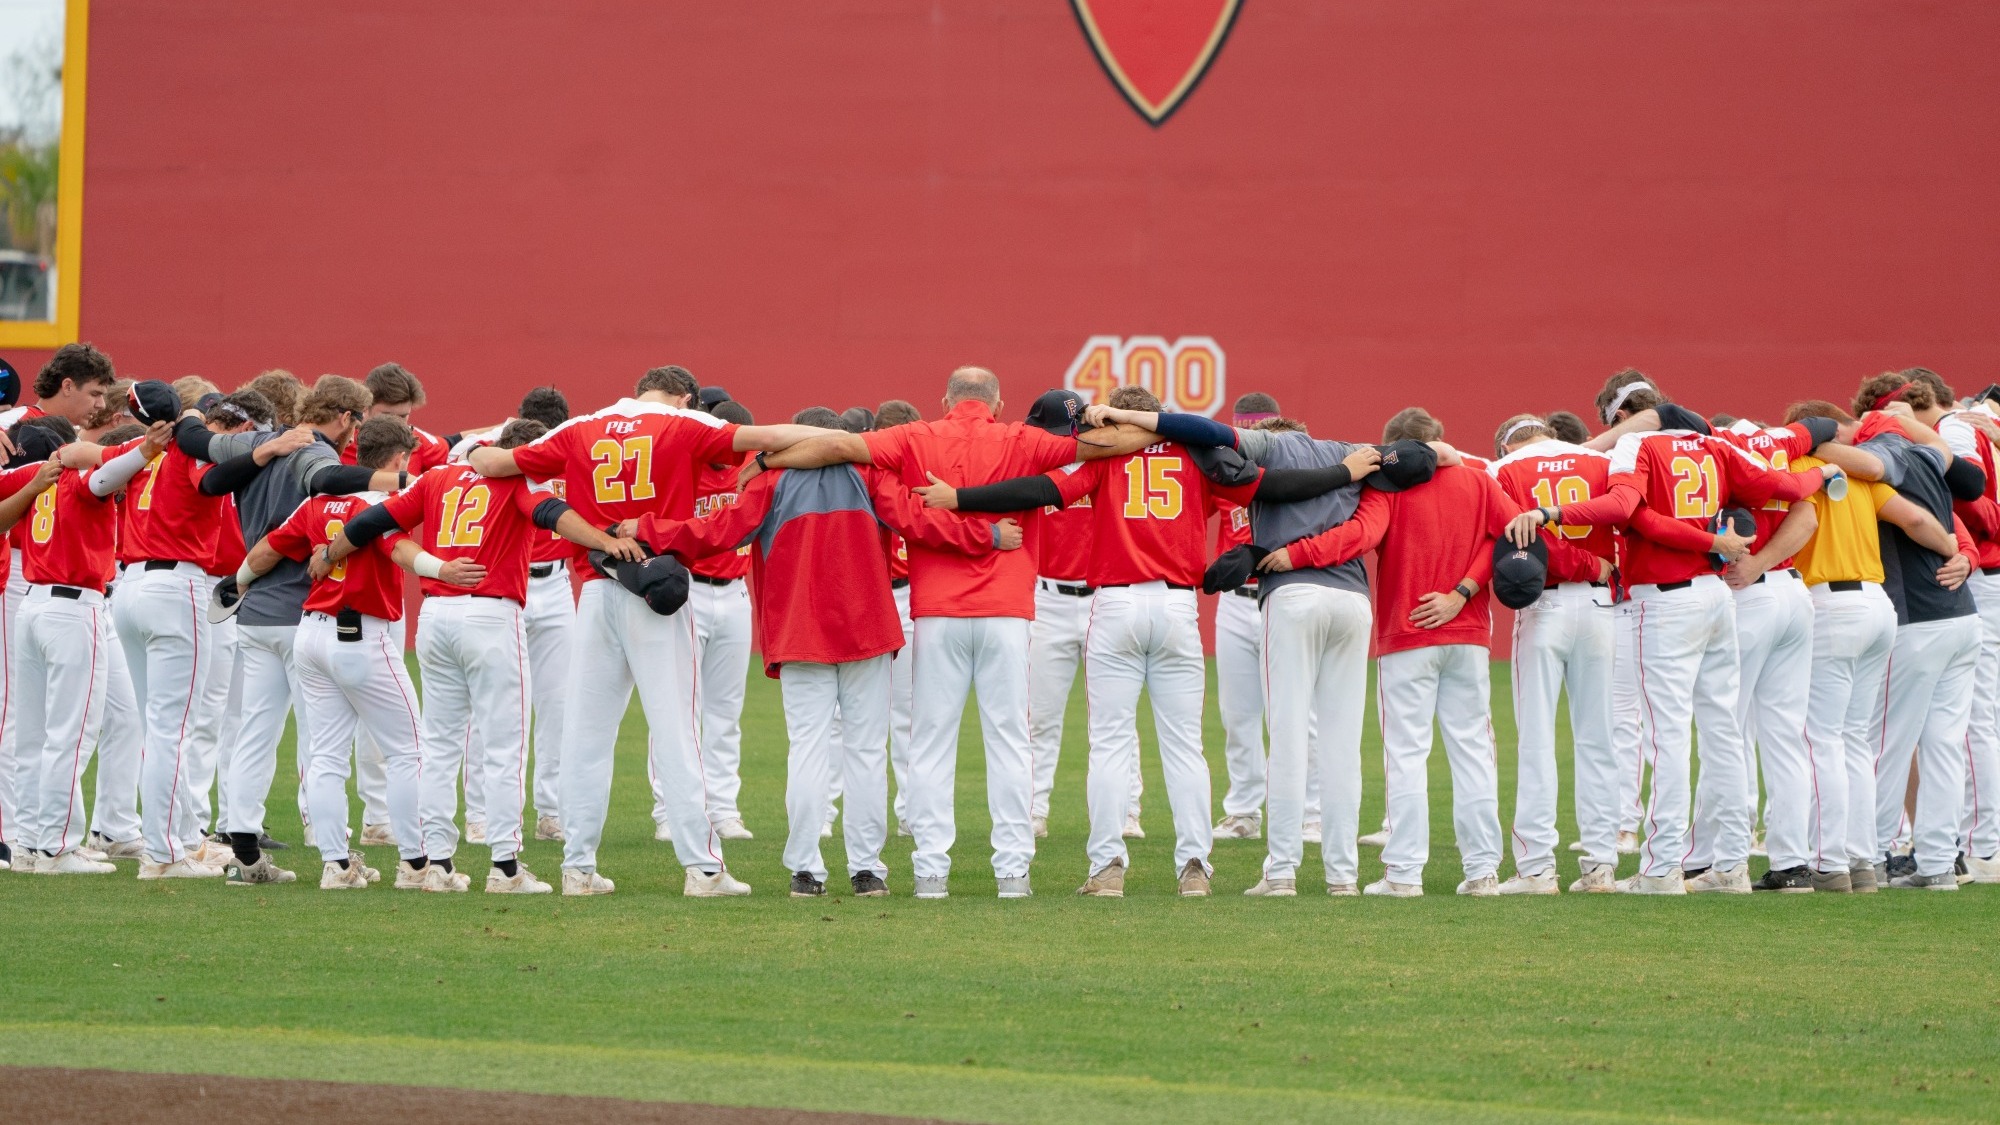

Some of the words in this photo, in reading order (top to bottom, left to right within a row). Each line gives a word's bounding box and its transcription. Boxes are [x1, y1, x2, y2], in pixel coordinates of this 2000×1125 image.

[1064, 336, 1226, 421] 400
[605, 420, 643, 434] PBC
[1144, 442, 1172, 454] BC
[1672, 438, 1705, 452] PBC
[591, 435, 656, 504] 27
[1124, 456, 1182, 520] 15
[1537, 459, 1576, 473] PBC
[1671, 455, 1719, 519] 21
[31, 482, 58, 544] 8
[323, 501, 352, 514] PBC
[437, 485, 491, 547] 12
